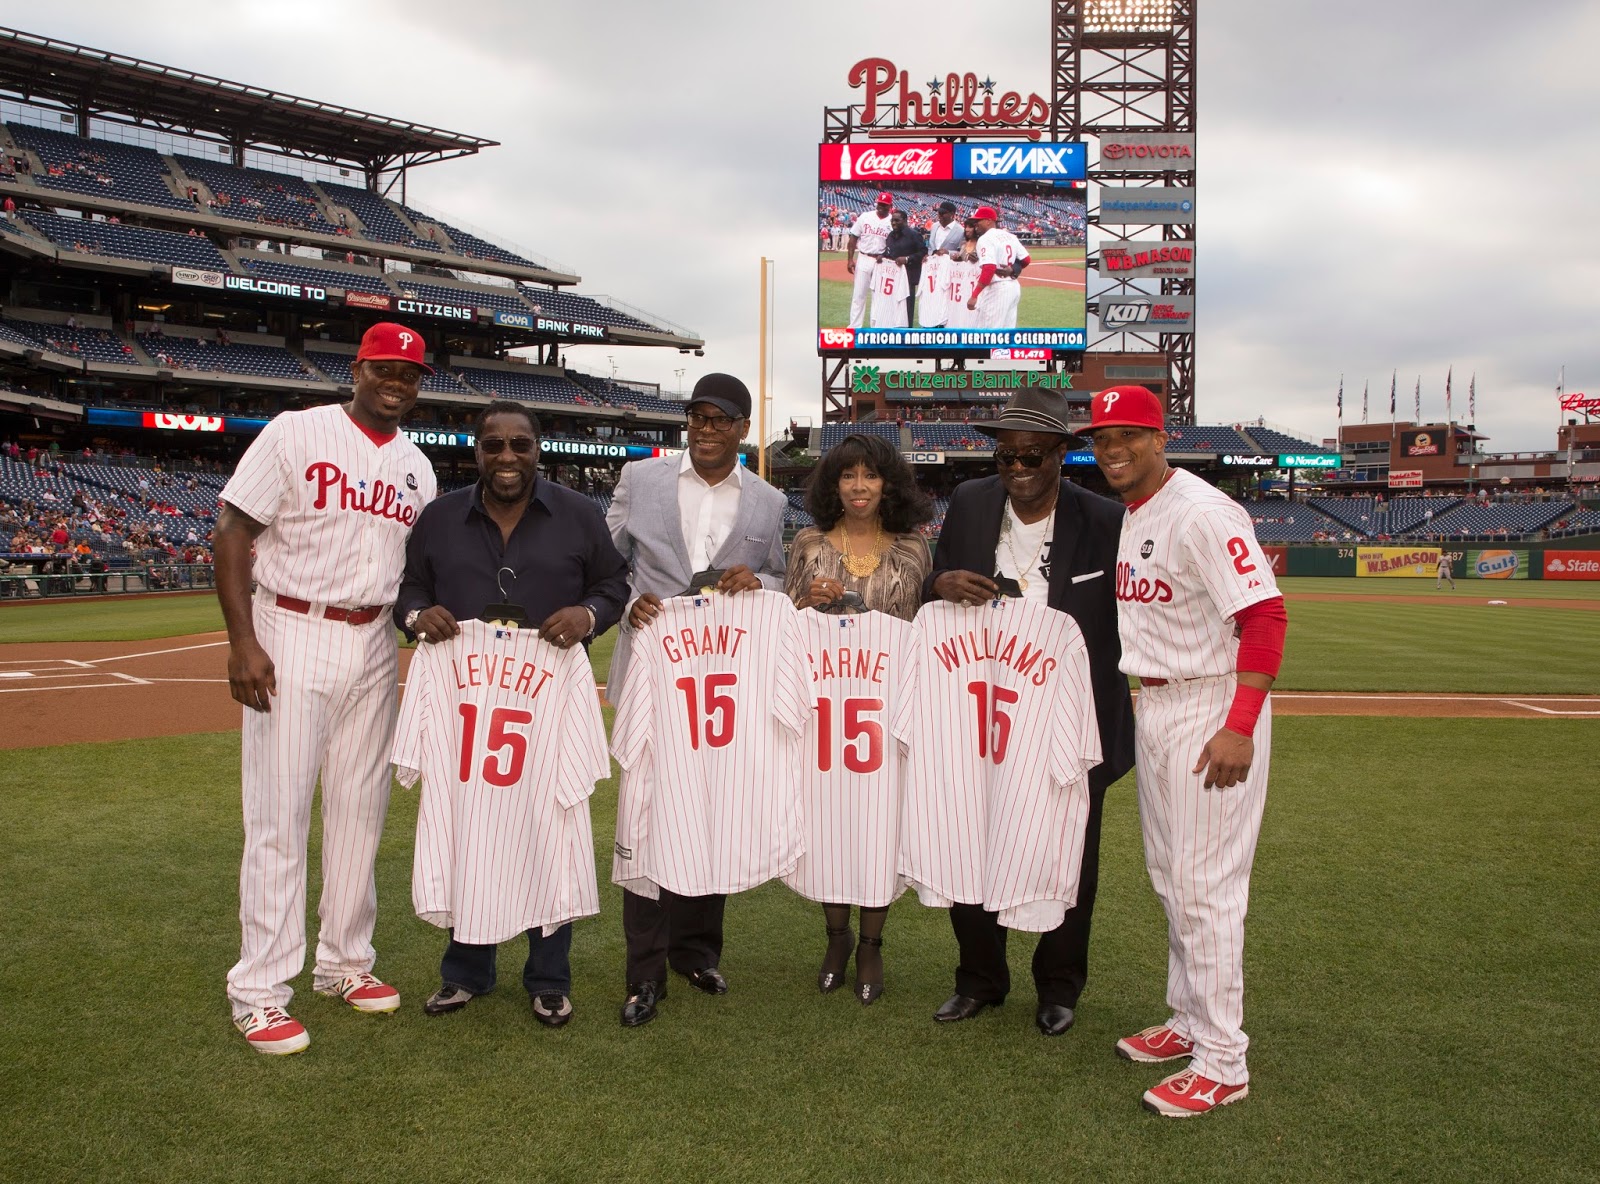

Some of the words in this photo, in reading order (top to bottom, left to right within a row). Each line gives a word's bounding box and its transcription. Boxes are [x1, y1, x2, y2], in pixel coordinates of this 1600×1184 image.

[848, 57, 1050, 125] Phillies
[855, 148, 938, 175] Coca-Cola
[970, 146, 1067, 175] RE/MAX
[1126, 145, 1191, 158] TOYOTA
[1102, 200, 1177, 212] Independence
[226, 276, 301, 297] WELCOME
[304, 286, 325, 300] TO
[397, 299, 472, 320] CITIZENS
[499, 313, 529, 326] GOYA
[1104, 304, 1151, 323] KDI
[537, 318, 569, 333] BANK
[573, 323, 604, 337] PARK
[398, 332, 413, 350] P
[858, 332, 902, 345] AFRICAN
[904, 332, 958, 345] AMERICAN
[961, 332, 1010, 345] HERITAGE
[1013, 332, 1083, 345] CELEBRATION
[885, 370, 968, 388] Citizens
[971, 369, 1022, 388] Bank
[1027, 369, 1074, 388] Park
[1103, 391, 1120, 413] P
[540, 442, 627, 457] CELEBRATION
[1232, 455, 1273, 465] NovaCare
[1295, 456, 1336, 466] NovaCare
[305, 461, 417, 527] Phillie
[1227, 537, 1256, 575] 2
[1338, 548, 1354, 558] 374
[1478, 556, 1516, 573] Gulf
[1566, 559, 1600, 572] State
[1116, 561, 1173, 603] llies
[662, 625, 747, 664] GRANT
[933, 628, 1057, 686] WILLIAMS
[452, 654, 554, 699] LEVERT
[676, 673, 737, 751] 15
[968, 681, 1019, 765] 15
[459, 702, 533, 787] 15
[815, 697, 884, 774] 15
